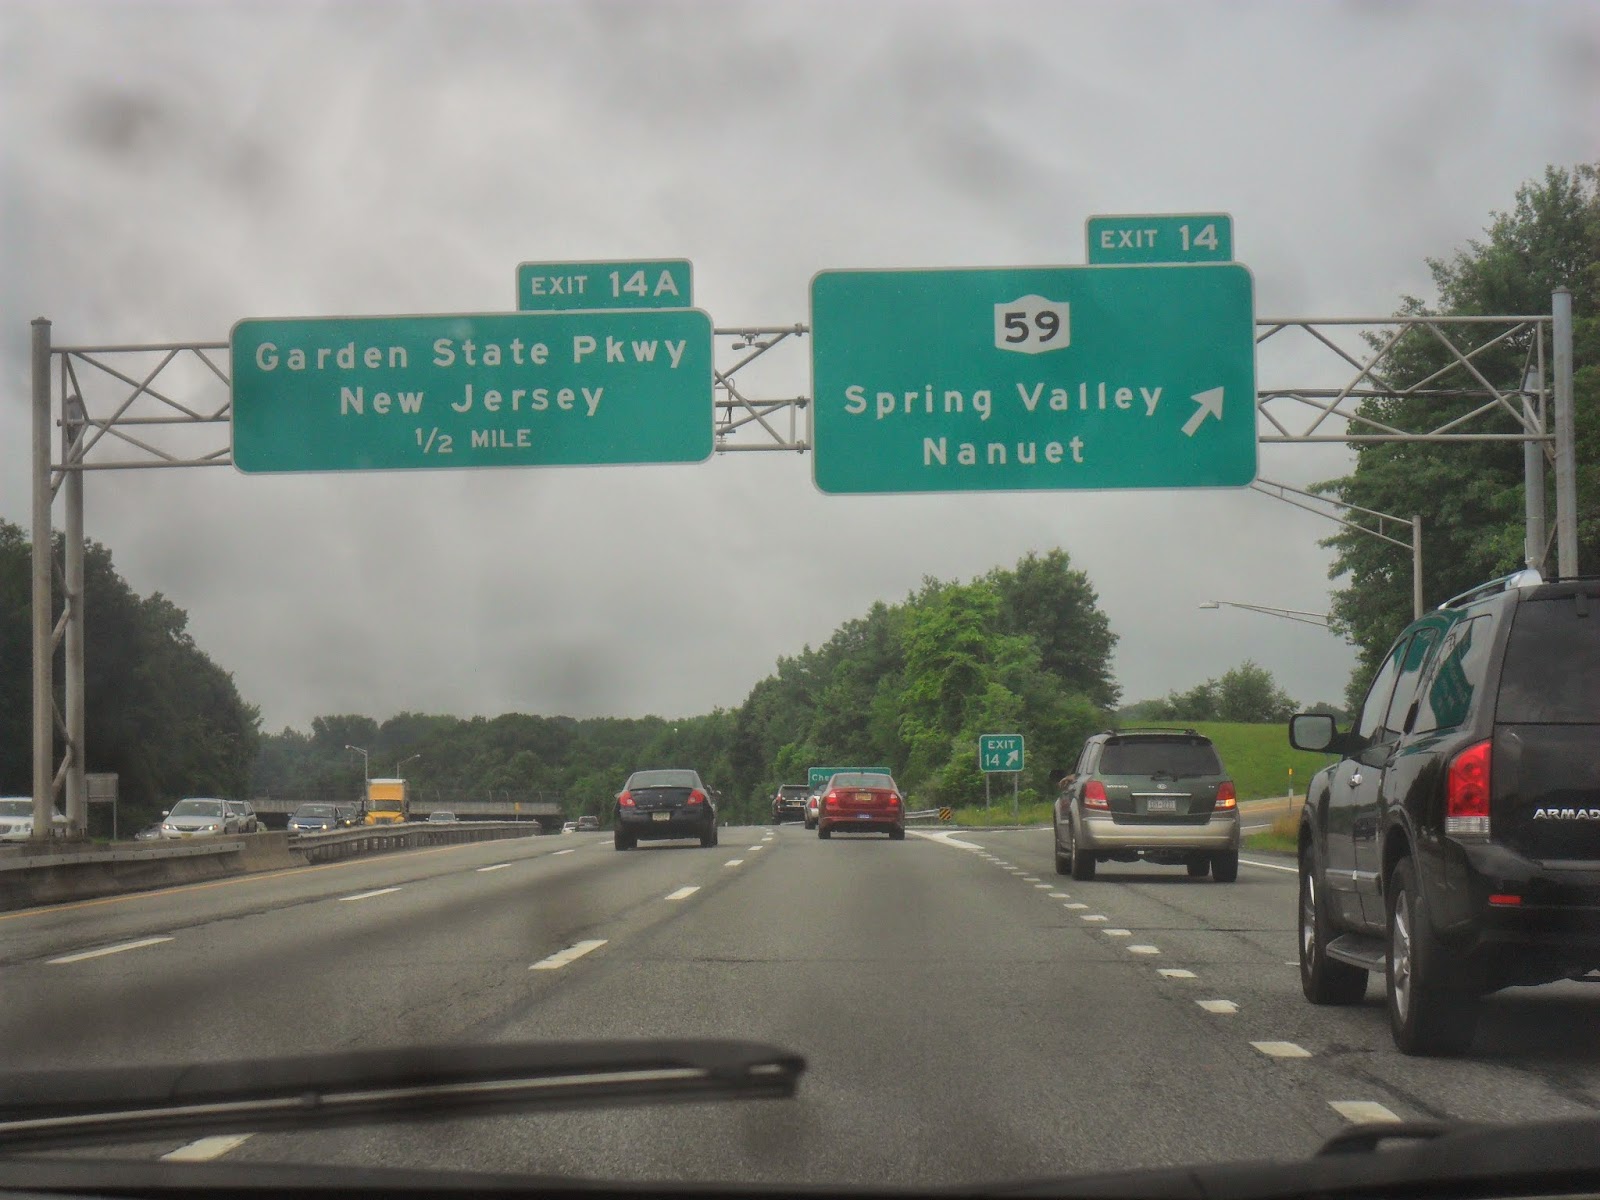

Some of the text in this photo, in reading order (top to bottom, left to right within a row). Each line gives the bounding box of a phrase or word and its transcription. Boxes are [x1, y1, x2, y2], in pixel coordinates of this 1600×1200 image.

[1100, 224, 1219, 251] EXIT 14
[531, 270, 679, 298] EXIT 14A
[1005, 310, 1059, 343] 59
[255, 335, 687, 372] Garden State Pkwy
[340, 383, 604, 417] New Jersey
[844, 382, 1163, 421] Spring Valley
[415, 427, 532, 454] 1/2 MILE
[923, 436, 1084, 466] Nanuet
[988, 740, 1015, 749] EXIT
[985, 754, 1000, 767] 14
[1533, 809, 1600, 820] ARMAD
